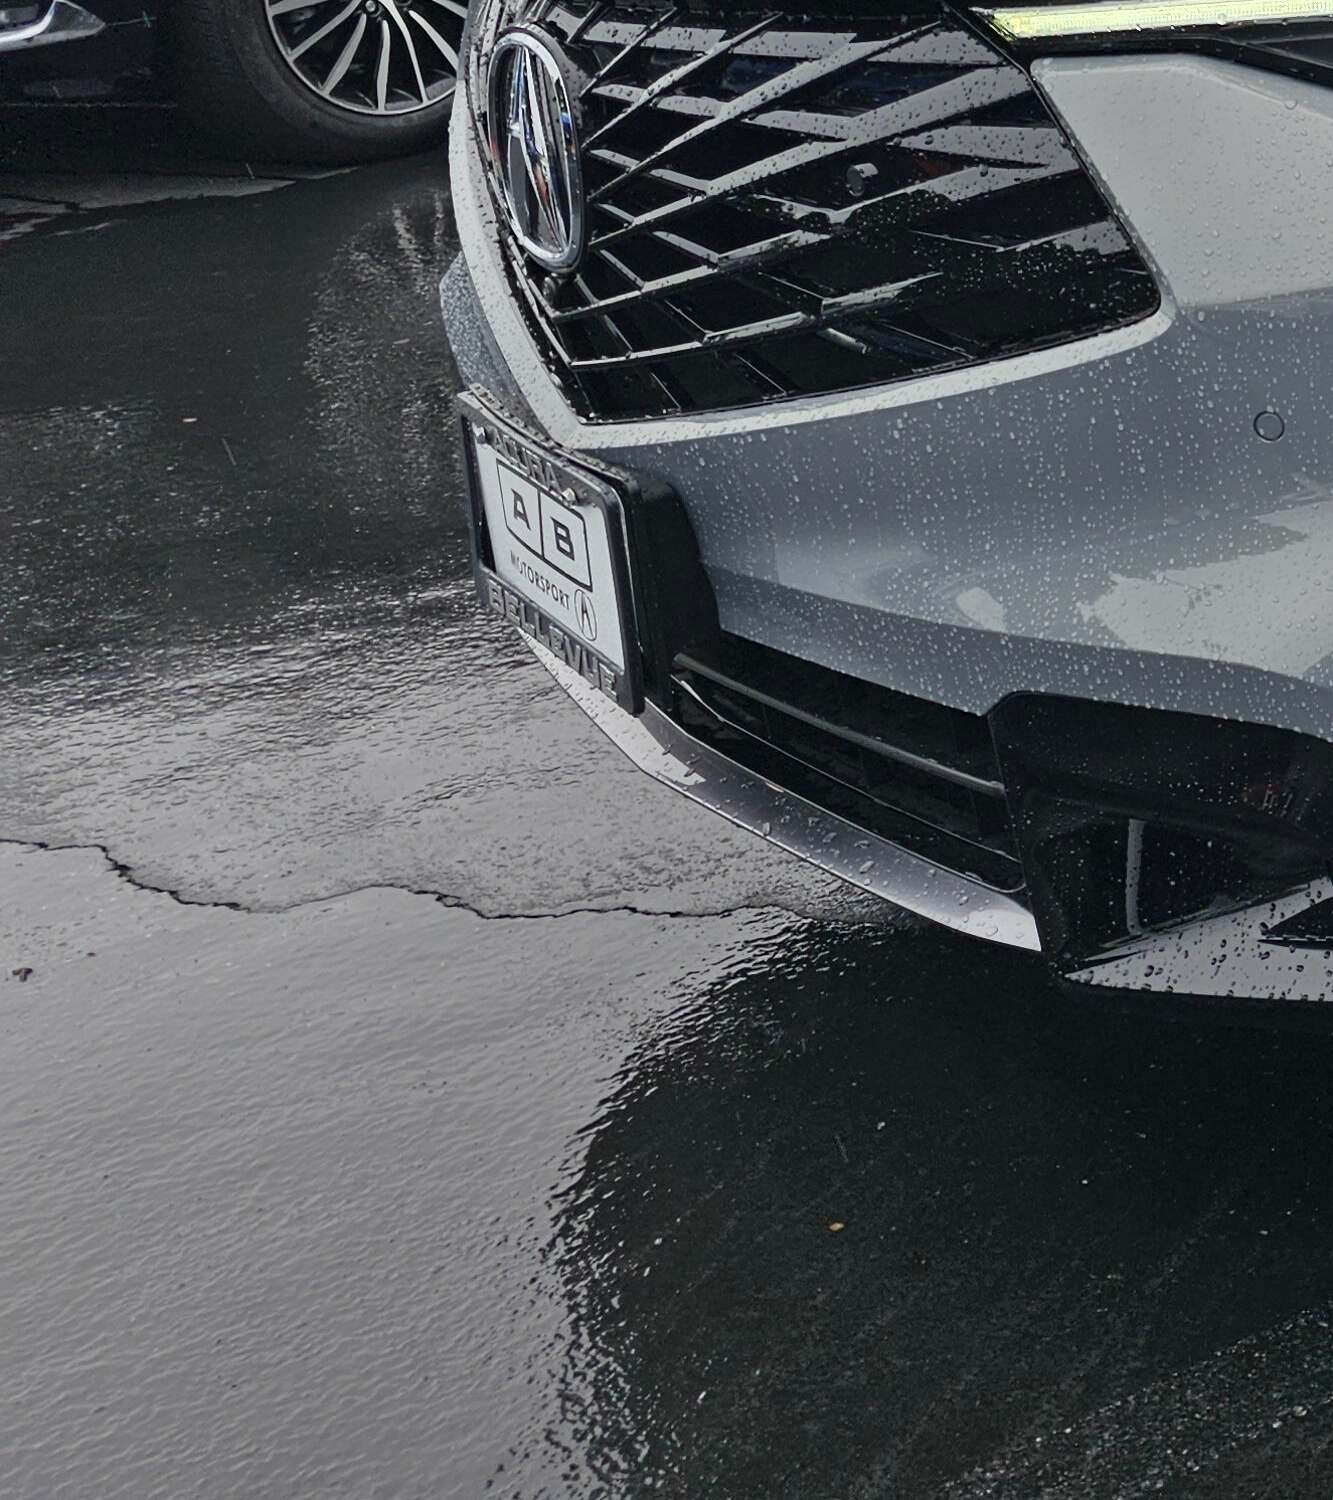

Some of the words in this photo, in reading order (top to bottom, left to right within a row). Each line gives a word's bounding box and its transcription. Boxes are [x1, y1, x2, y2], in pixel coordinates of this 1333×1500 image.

[493, 426, 563, 501] ACURA
[511, 488, 532, 531] A
[552, 516, 575, 561] B
[510, 549, 570, 611] MOTORSPORT
[487, 578, 618, 702] BELLEVUE
